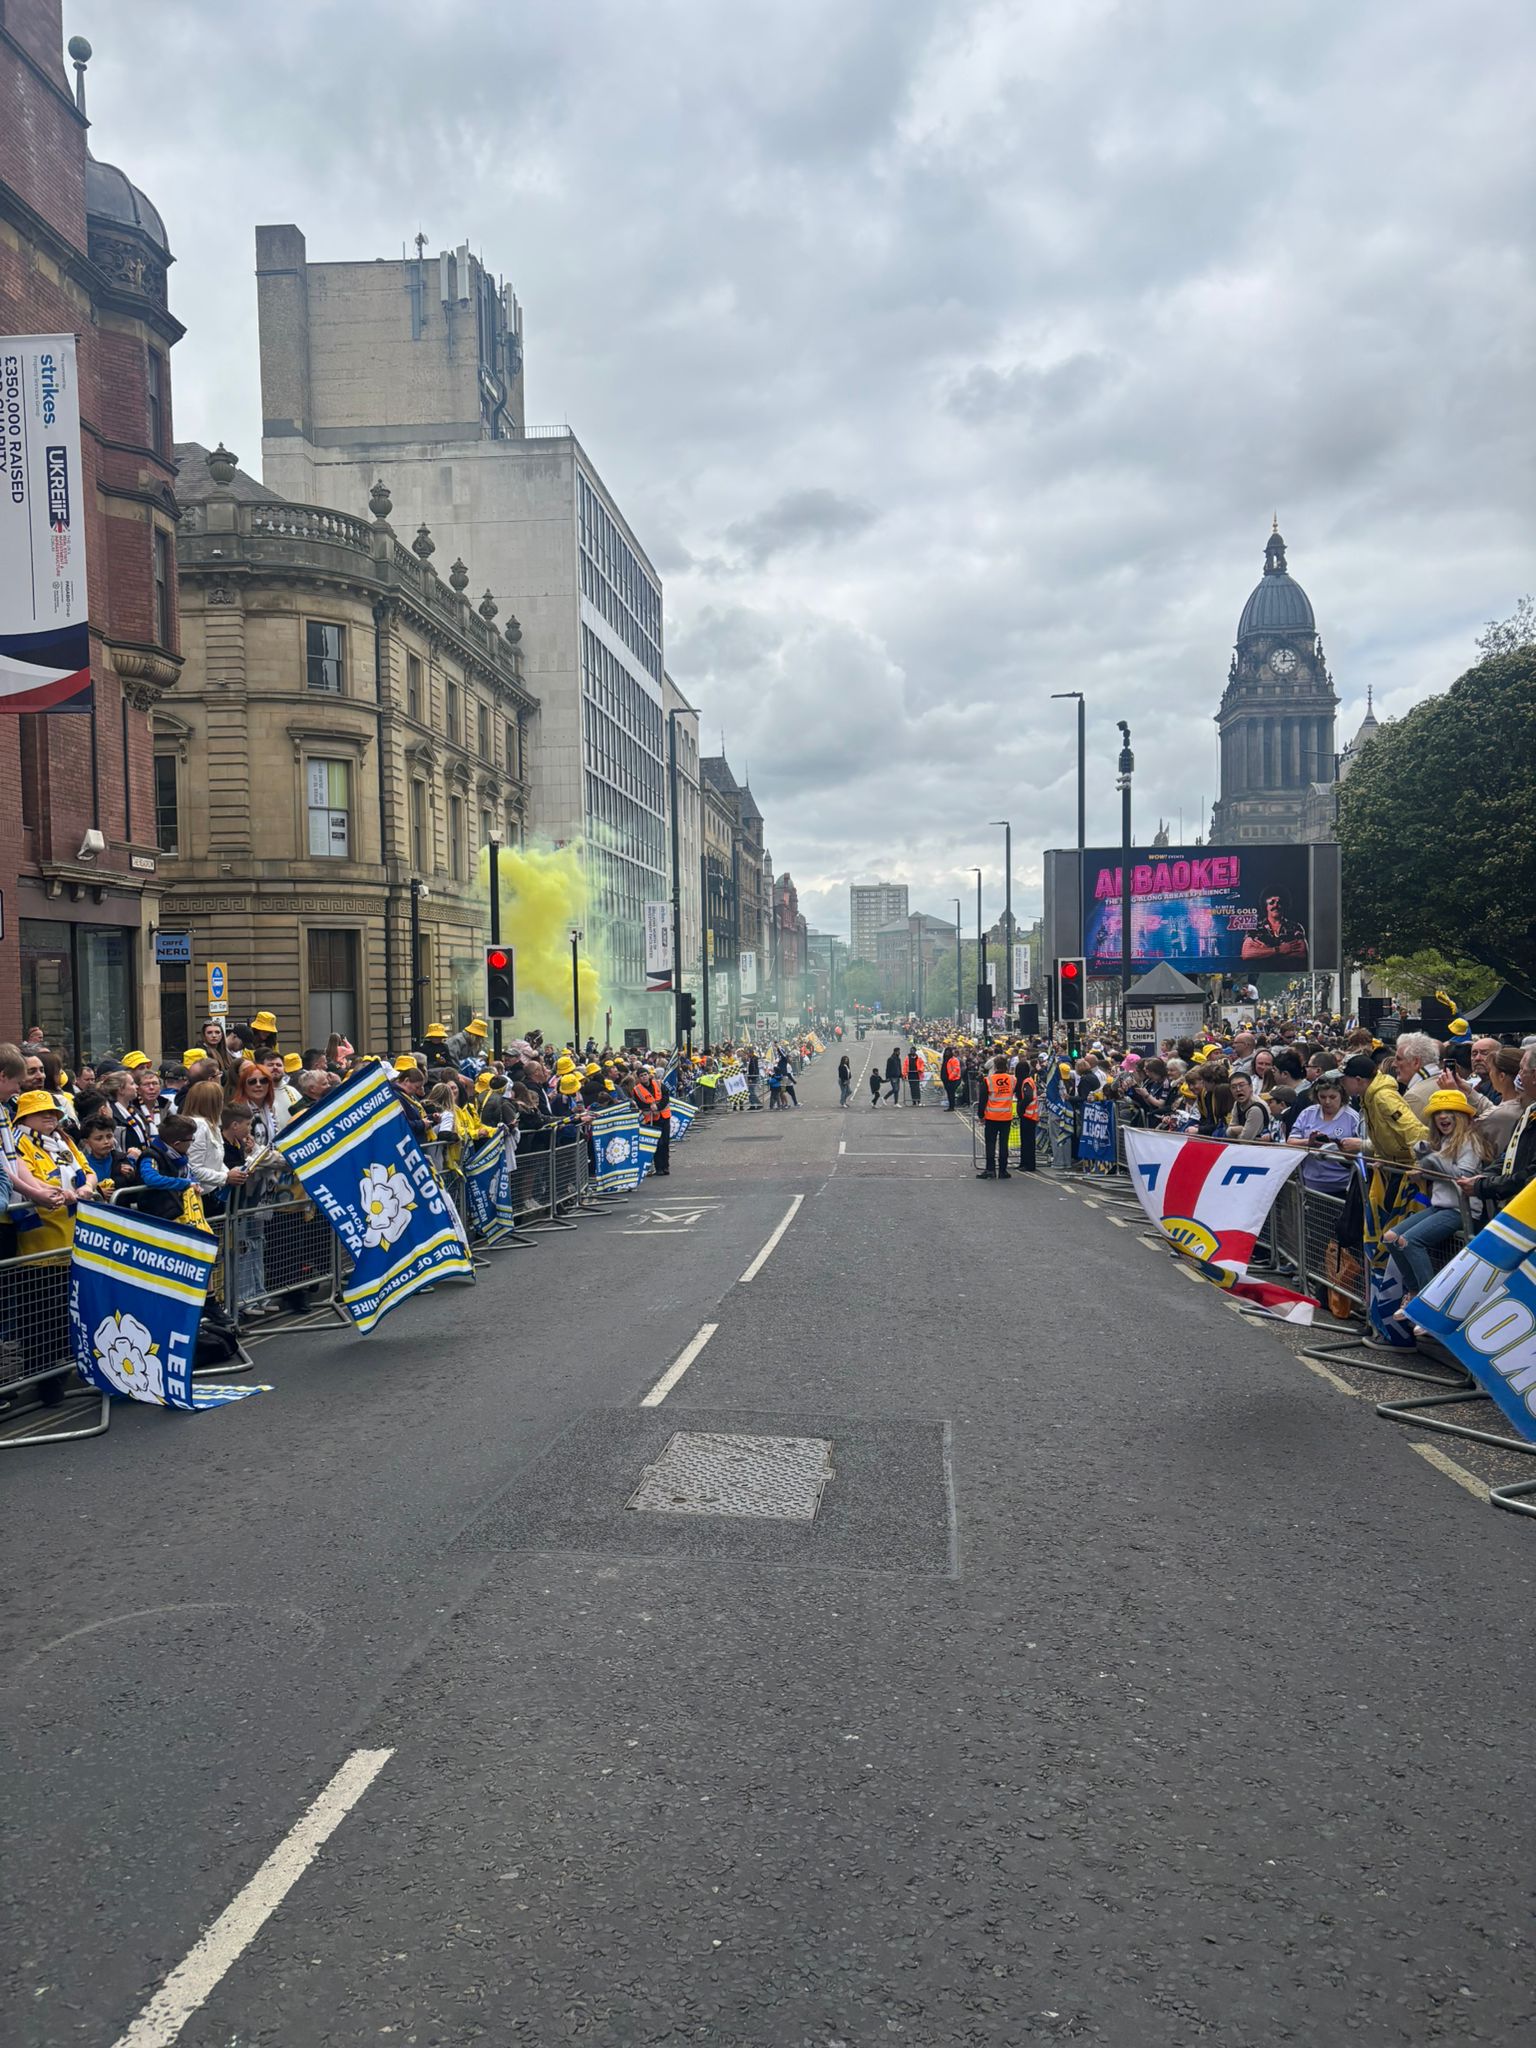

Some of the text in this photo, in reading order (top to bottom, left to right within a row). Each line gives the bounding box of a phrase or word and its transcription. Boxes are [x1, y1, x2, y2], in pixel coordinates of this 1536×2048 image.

[4, 356, 24, 503] £350,000 RAISED
[157, 948, 189, 956] NERO
[288, 1087, 393, 1164] PRIDE OF YORKSHIRE
[396, 1135, 446, 1213] LEEDS
[498, 1160, 509, 1199] EEDS
[312, 1184, 339, 1221] THE
[346, 1203, 365, 1235] BACK
[469, 1180, 481, 1198] THE
[475, 1196, 488, 1222] PREM
[75, 1226, 206, 1282] PRIDE OF YORKSHIRE
[417, 1256, 433, 1271] OF
[351, 1268, 417, 1317] YORKSHIRE
[168, 1331, 191, 1409] LEE
